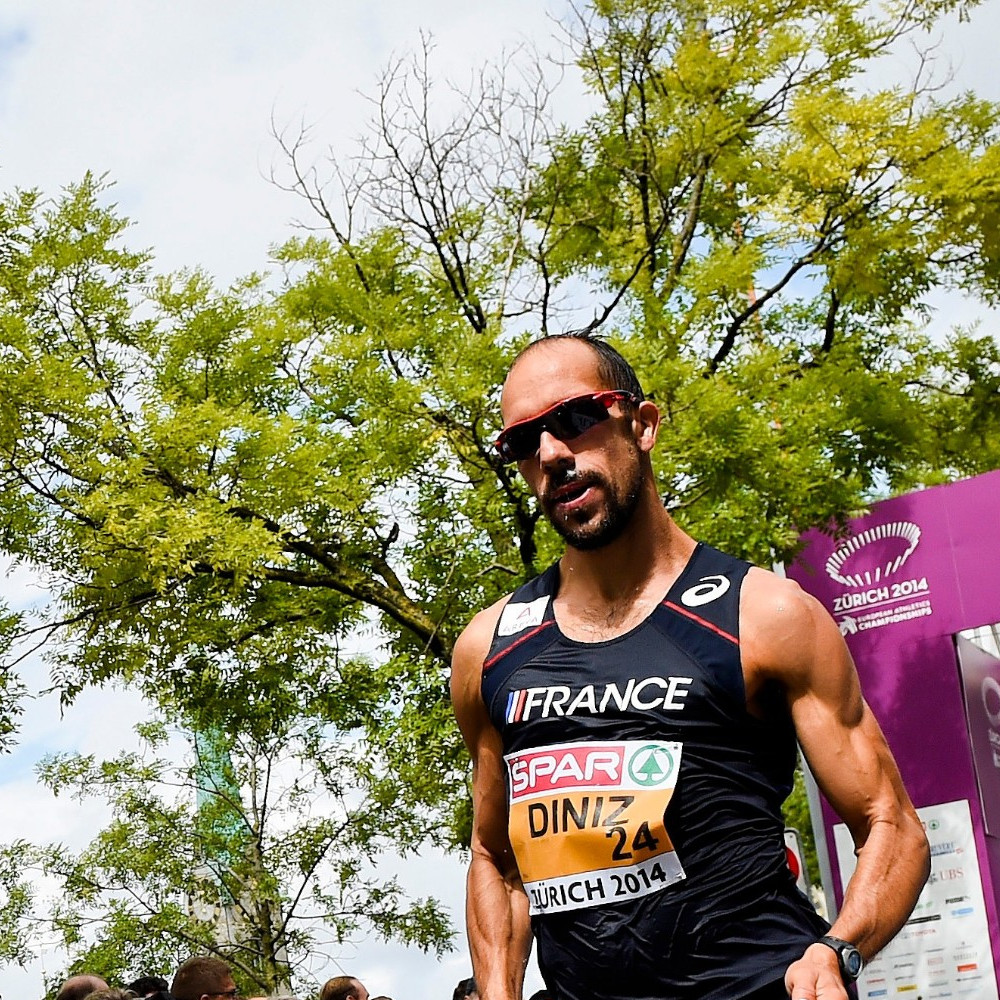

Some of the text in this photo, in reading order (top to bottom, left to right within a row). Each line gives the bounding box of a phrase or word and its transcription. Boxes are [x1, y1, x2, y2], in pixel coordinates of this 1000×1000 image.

[834, 577, 928, 611] ZÜRICH 2014
[859, 607, 932, 630] CHAMPIONSHIPS
[522, 676, 693, 722] FRANCE
[511, 751, 621, 793] SPAR
[528, 796, 635, 838] DINIZ
[605, 821, 659, 861] 24
[610, 863, 667, 896] 2014
